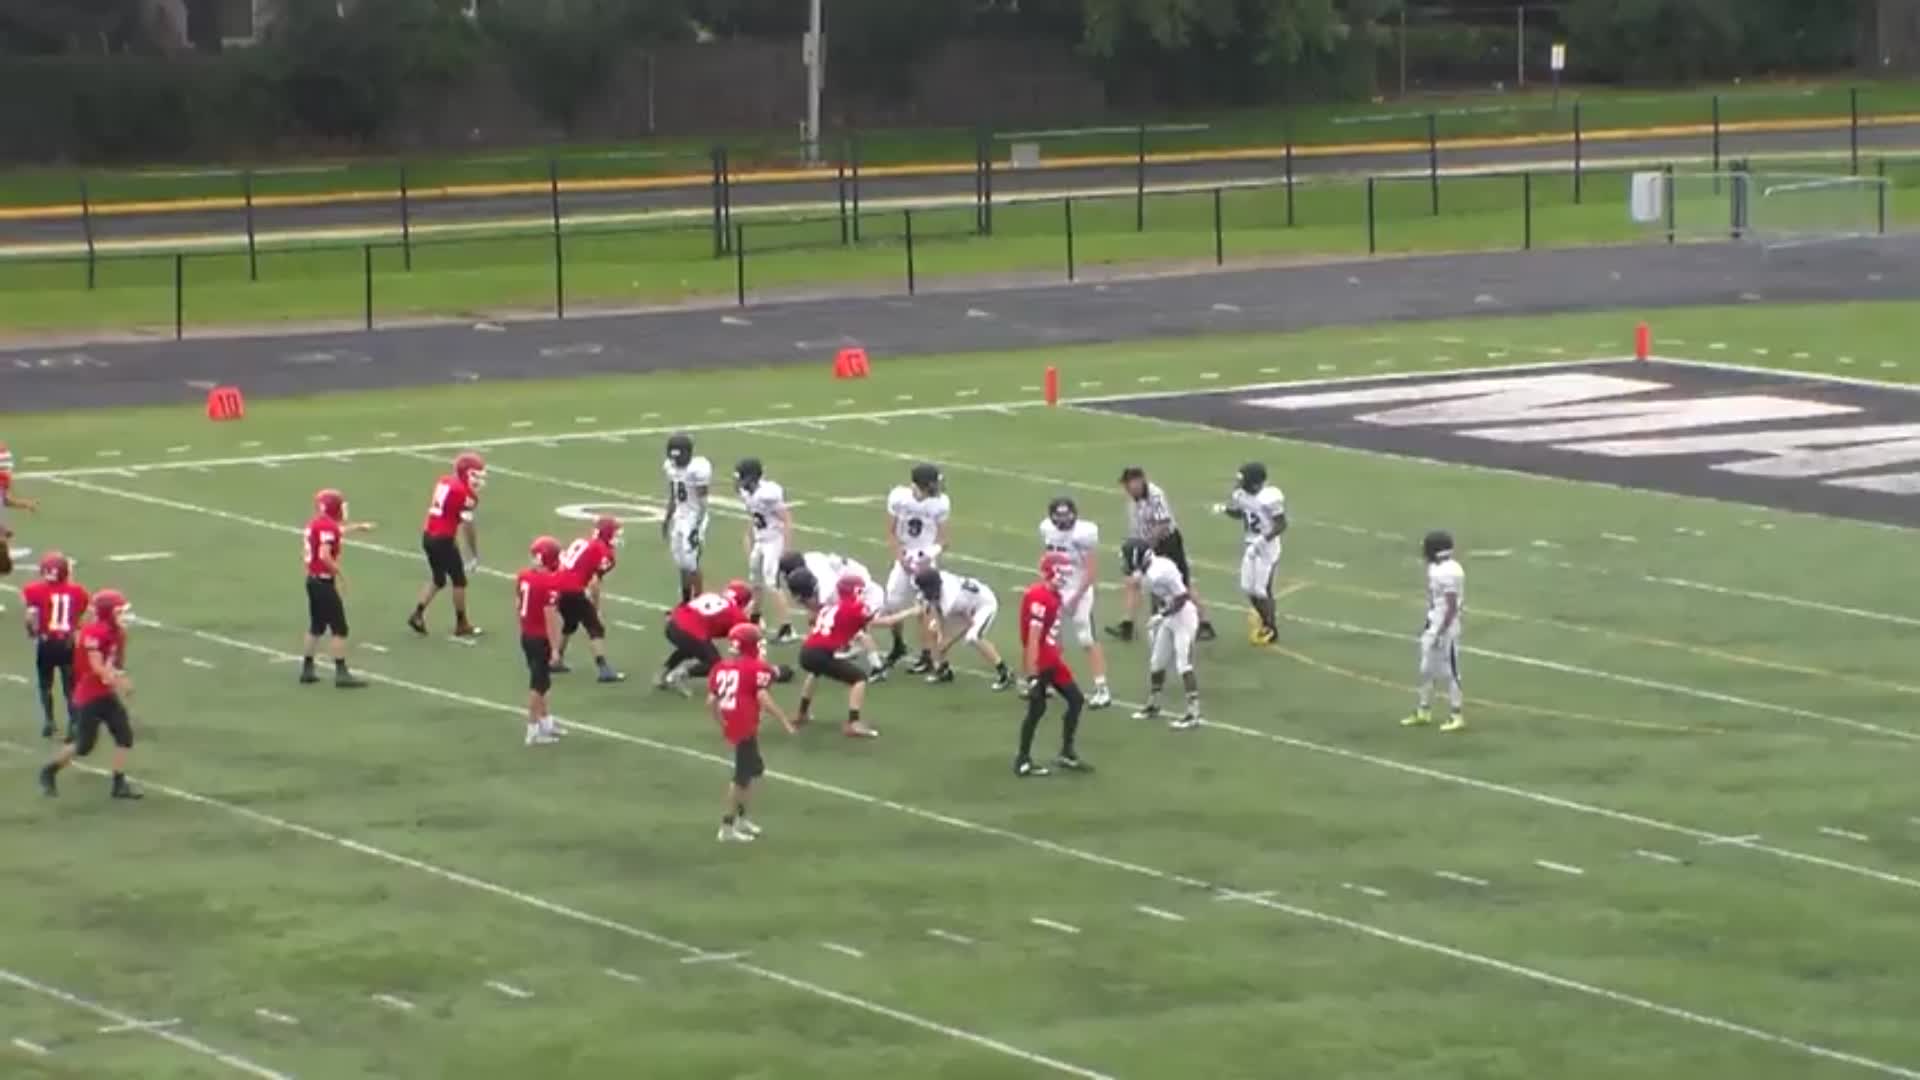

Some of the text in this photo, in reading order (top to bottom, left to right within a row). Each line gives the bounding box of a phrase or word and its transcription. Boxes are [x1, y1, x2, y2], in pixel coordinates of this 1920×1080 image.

[218, 393, 239, 417] 10
[50, 593, 71, 632] 11
[716, 669, 740, 711] 22
